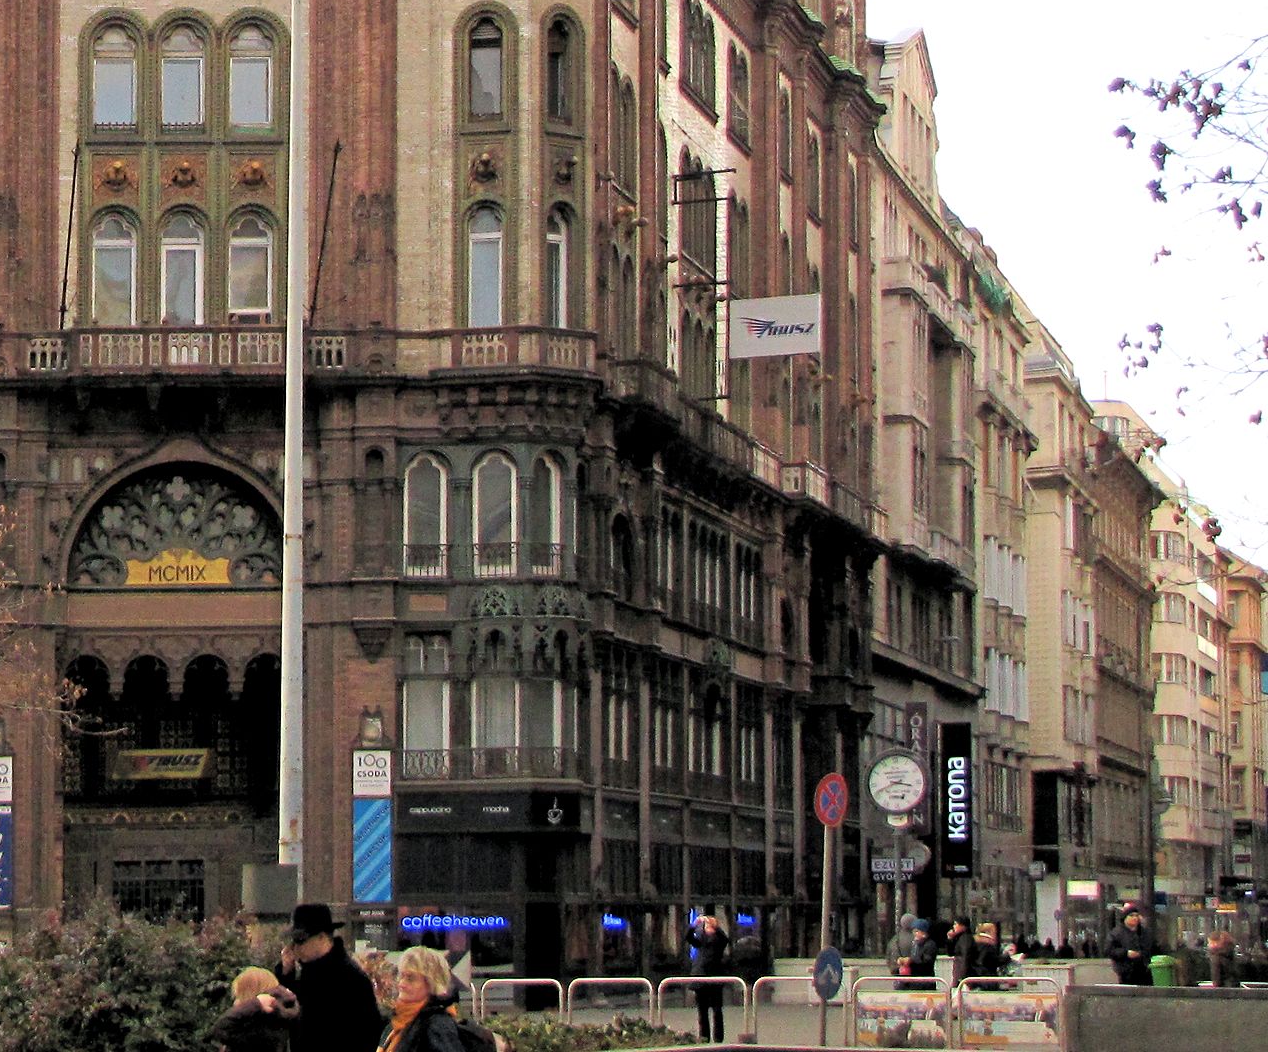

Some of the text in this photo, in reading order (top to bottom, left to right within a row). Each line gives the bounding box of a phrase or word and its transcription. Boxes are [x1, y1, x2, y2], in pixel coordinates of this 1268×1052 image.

[148, 564, 207, 582] MCMIX
[357, 753, 387, 769] 100
[357, 770, 388, 778] CSODA
[401, 913, 505, 928] coffeeheaven
